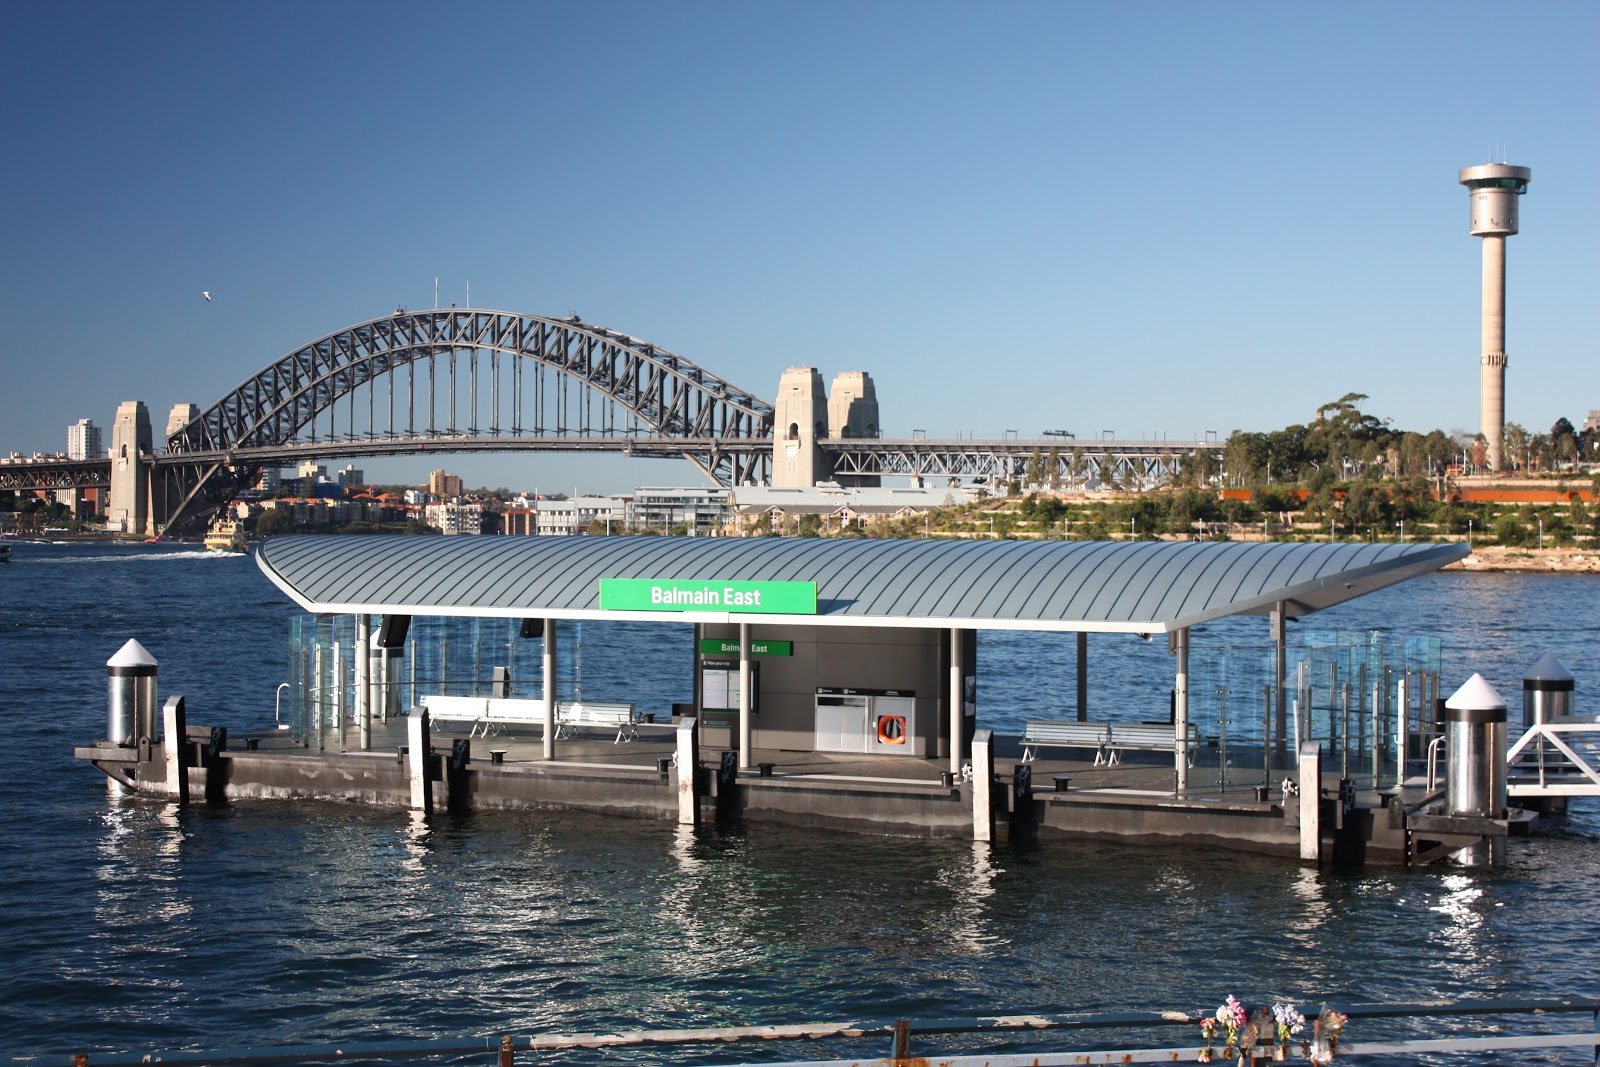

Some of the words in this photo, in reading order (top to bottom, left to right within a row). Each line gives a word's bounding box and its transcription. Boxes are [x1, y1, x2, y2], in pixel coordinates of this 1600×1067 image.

[651, 586, 719, 605] Balmain
[723, 587, 761, 606] East
[721, 643, 740, 652] Balm
[751, 644, 768, 652] East
